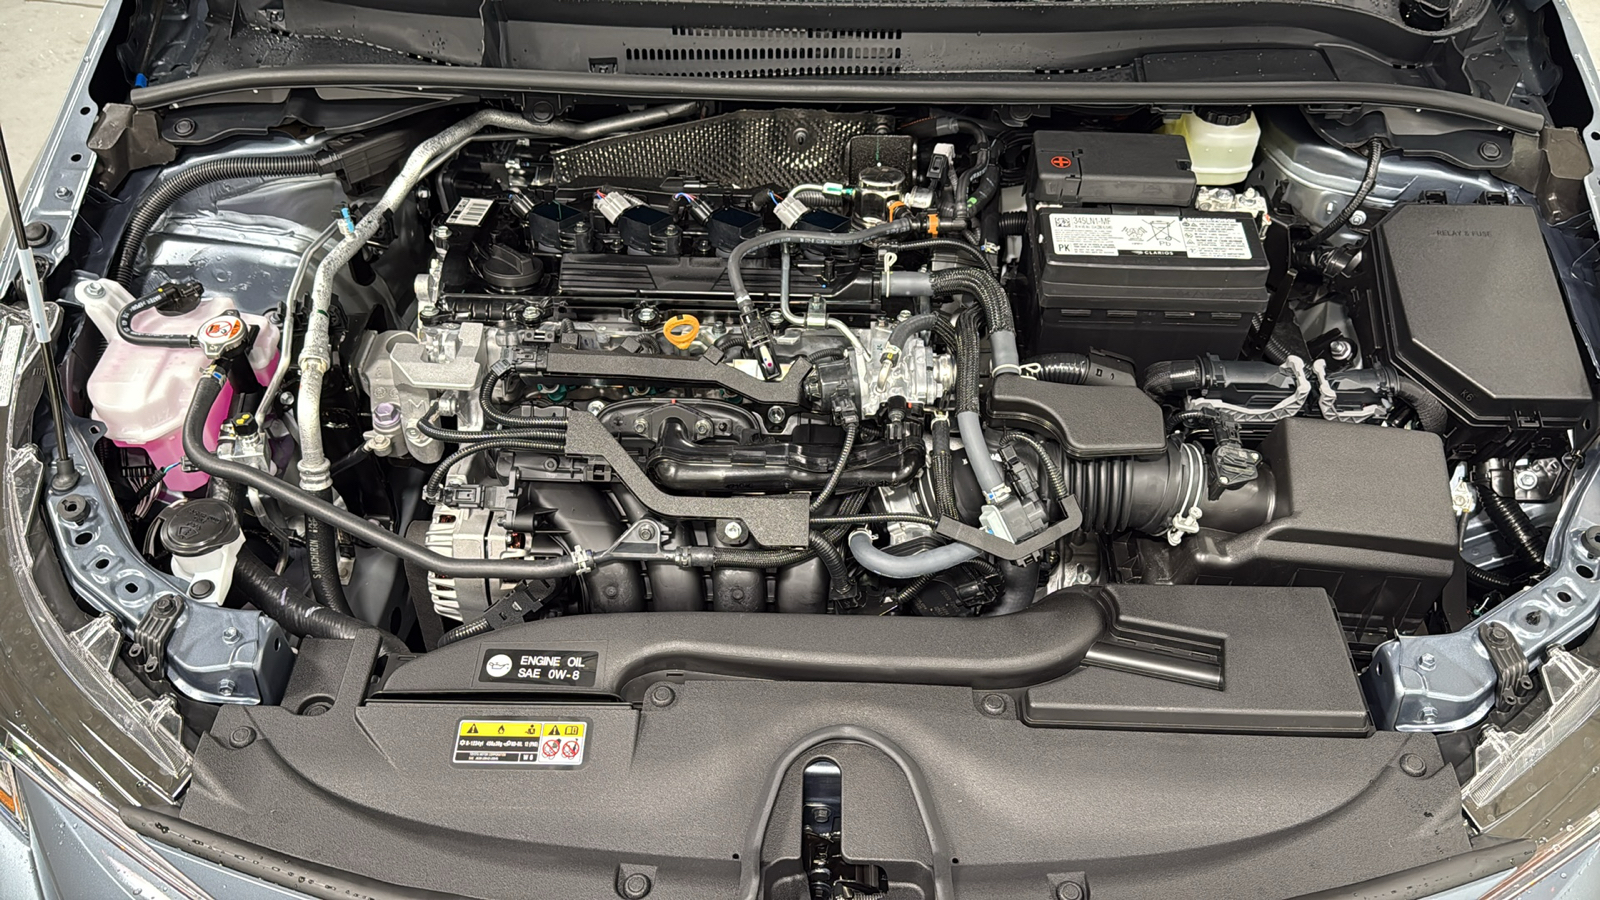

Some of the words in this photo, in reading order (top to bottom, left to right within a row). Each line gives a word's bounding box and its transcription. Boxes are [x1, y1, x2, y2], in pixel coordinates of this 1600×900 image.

[1436, 229, 1461, 237] RELAY
[1472, 230, 1493, 238] FUSE
[1058, 244, 1071, 252] PK
[1460, 389, 1474, 402] K6
[309, 539, 321, 572] NICHIRIN
[520, 655, 561, 667] ENGINE
[567, 657, 585, 668] OIL
[517, 668, 542, 679] SAE
[547, 670, 580, 680] 0W-8
